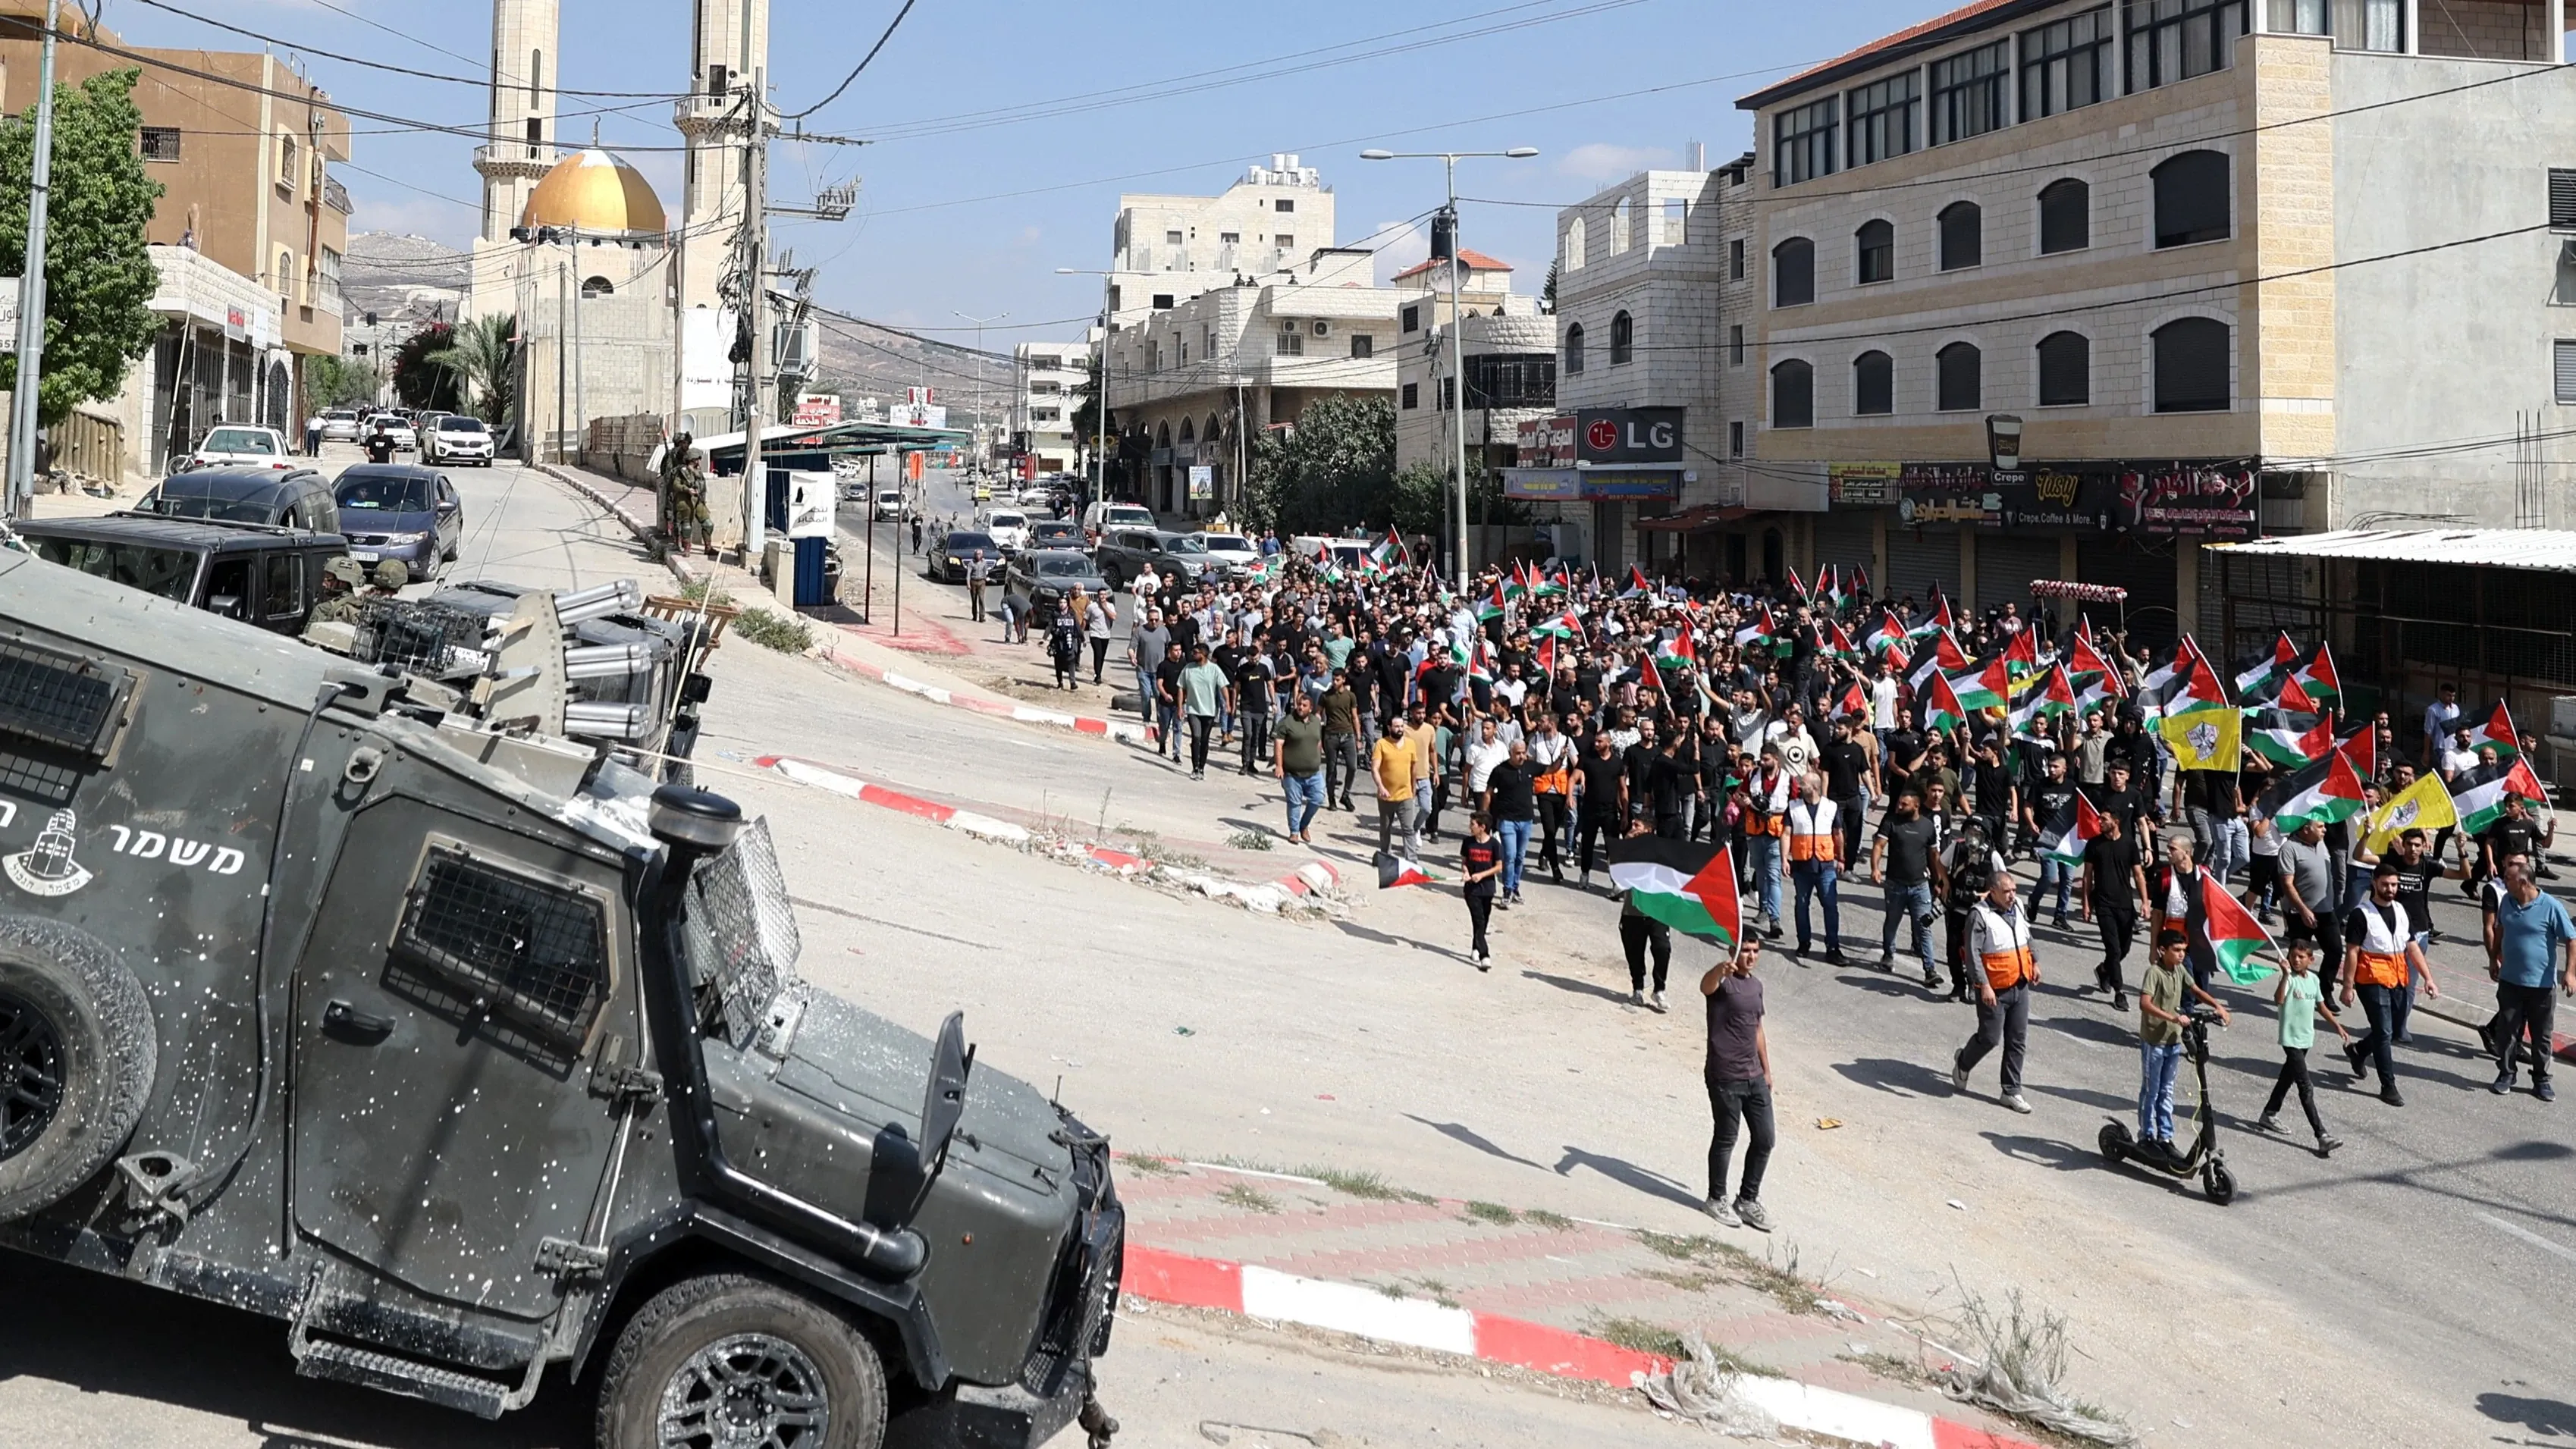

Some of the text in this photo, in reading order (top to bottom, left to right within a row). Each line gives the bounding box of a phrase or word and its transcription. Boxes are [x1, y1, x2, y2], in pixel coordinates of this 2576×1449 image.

[0, 304, 21, 322] الون
[1627, 422, 1673, 448] LG
[1994, 473, 2025, 483] Crepe
[2066, 513, 2070, 523] &
[110, 824, 245, 874] משמר
[48, 877, 80, 894] משמר
